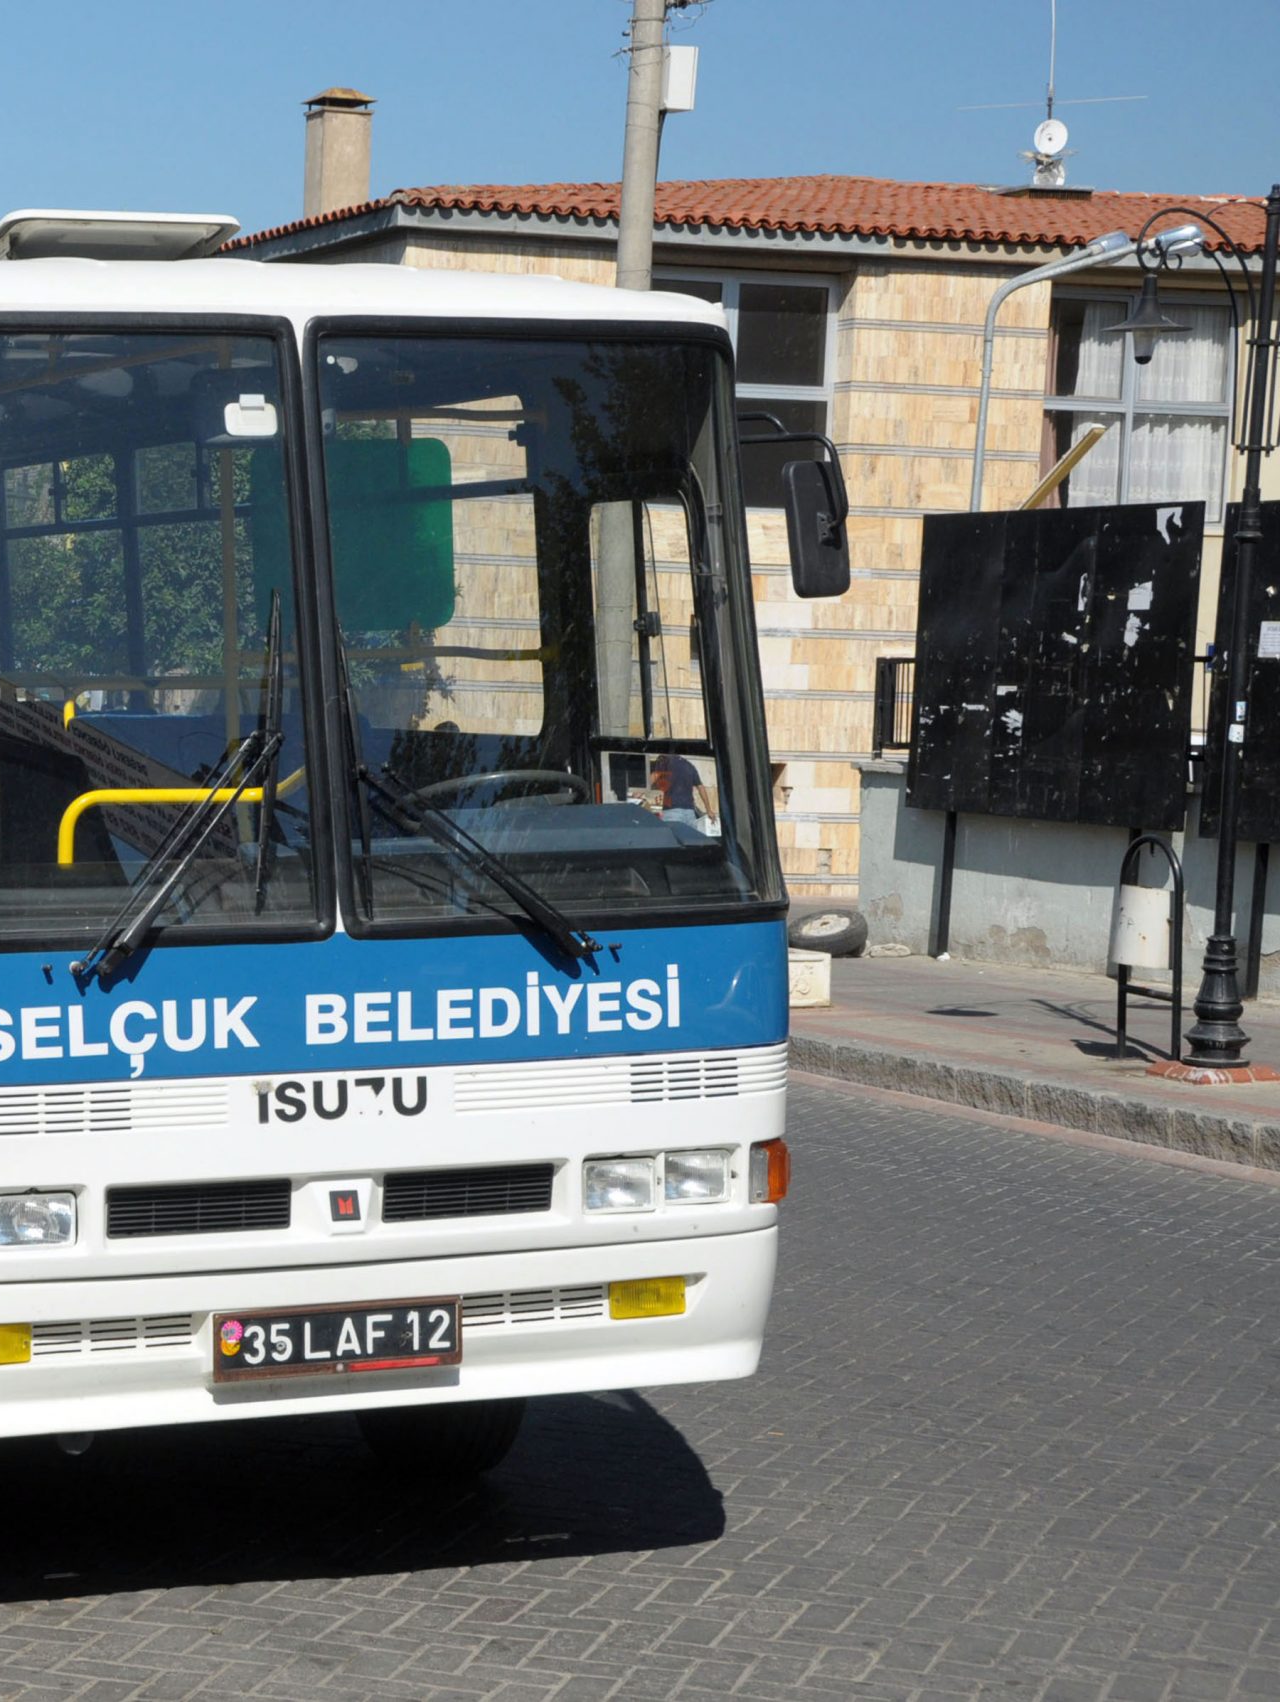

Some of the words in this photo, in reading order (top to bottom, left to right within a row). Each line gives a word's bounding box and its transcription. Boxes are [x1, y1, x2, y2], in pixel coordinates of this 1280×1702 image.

[305, 964, 680, 1045] BELEDİYESİ
[243, 1323, 293, 1365] 35
[303, 1314, 394, 1360] LAF
[406, 1308, 452, 1351] 12
